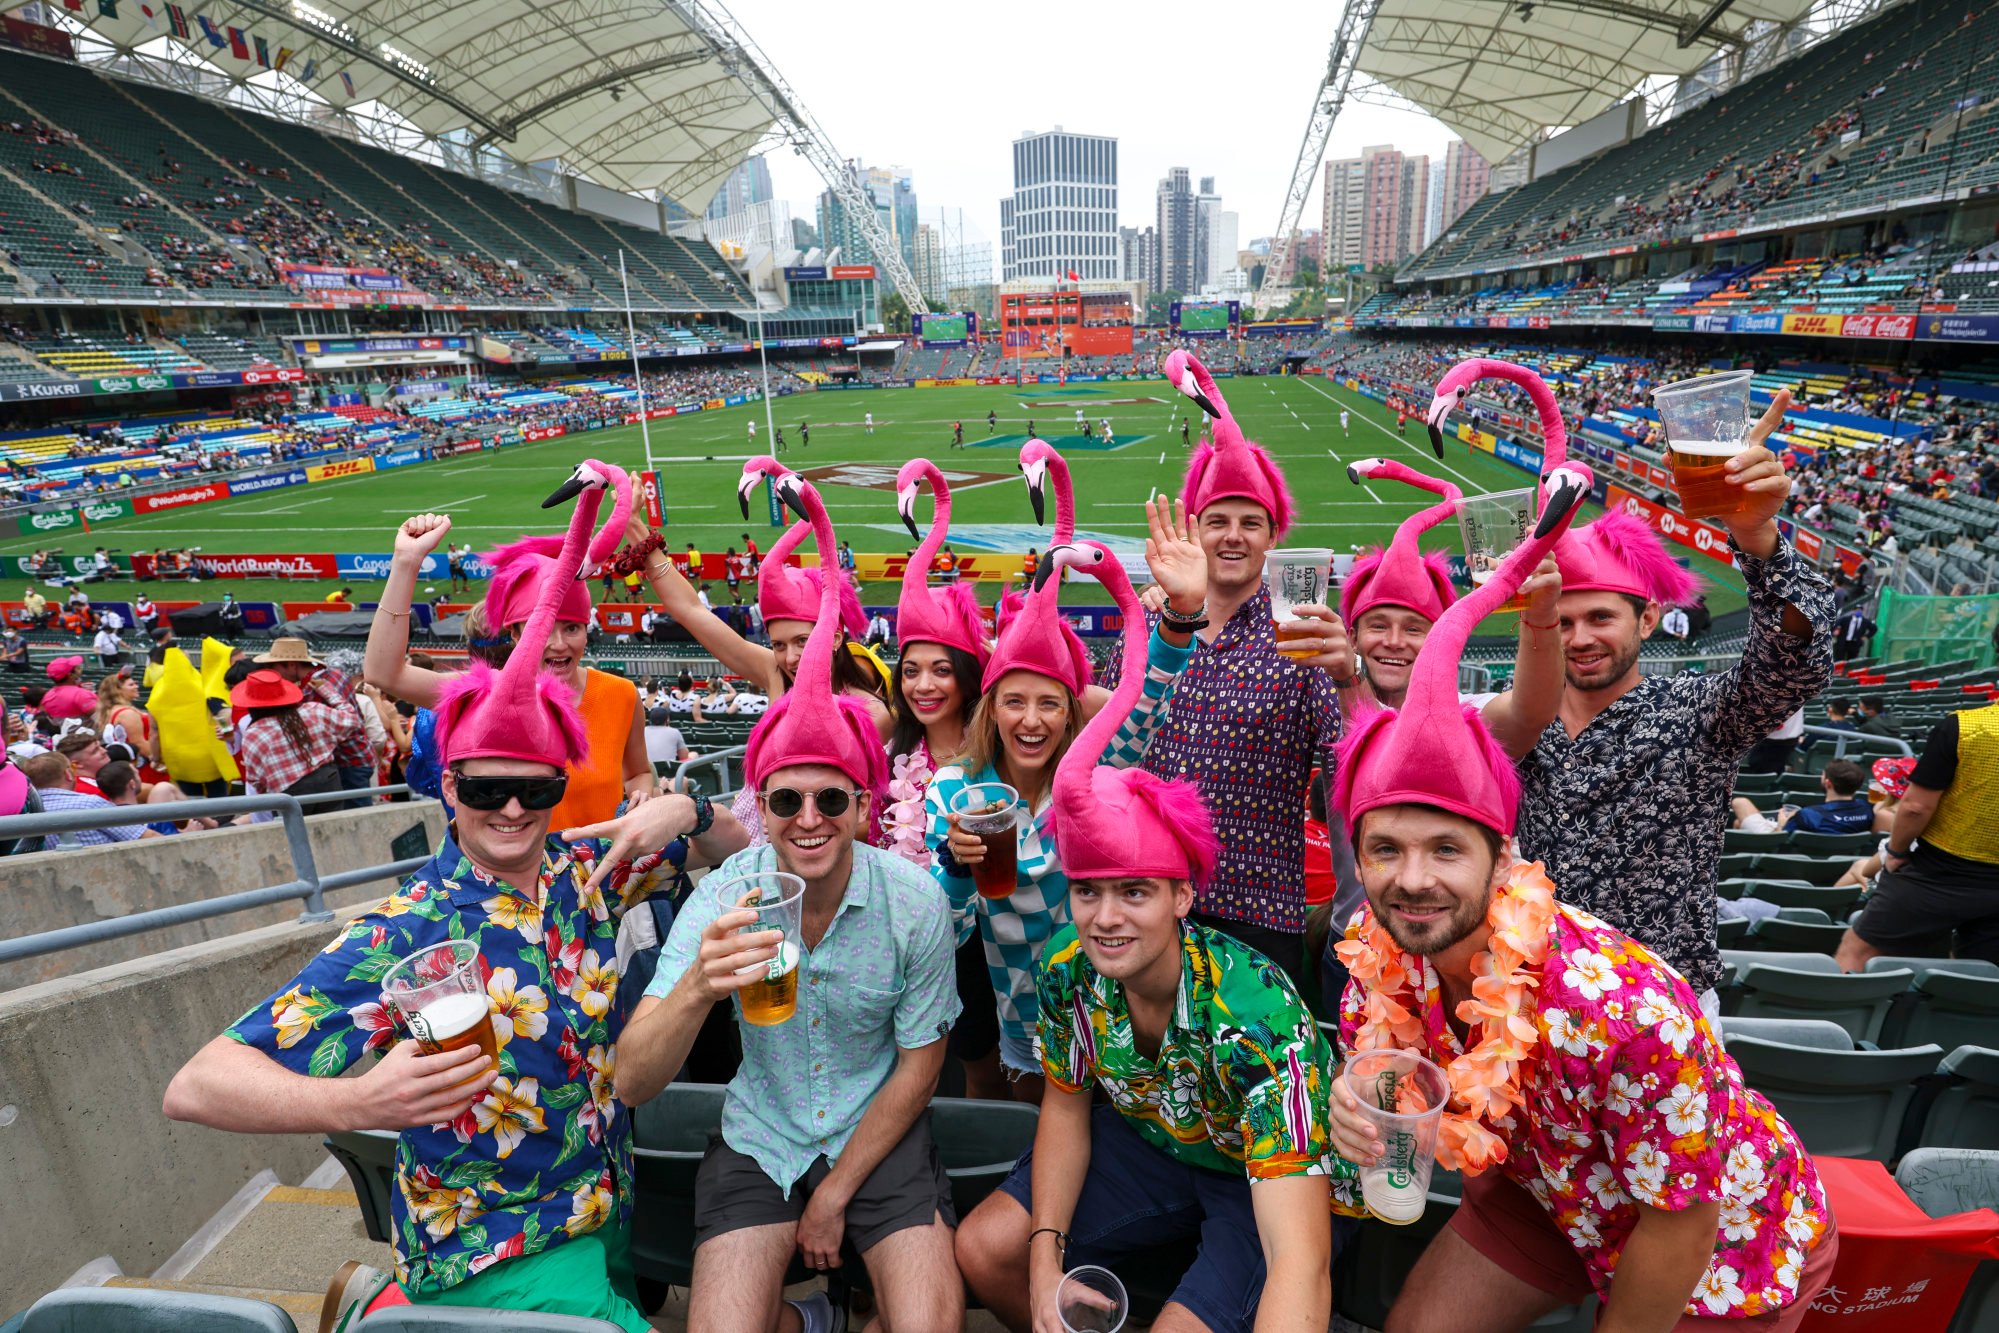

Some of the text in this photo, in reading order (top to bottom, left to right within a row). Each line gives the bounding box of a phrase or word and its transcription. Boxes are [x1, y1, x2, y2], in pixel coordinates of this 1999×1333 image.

[1794, 317, 1828, 333] DHL
[30, 384, 80, 397] KUKRI
[322, 462, 362, 478] DHL
[32, 512, 74, 530] Carlsberg
[354, 555, 392, 577] Capge
[1305, 837, 1321, 847] THAY
[1387, 1131, 1417, 1190] Carlsberg
[1806, 1294, 1920, 1315] NG STADIUM
